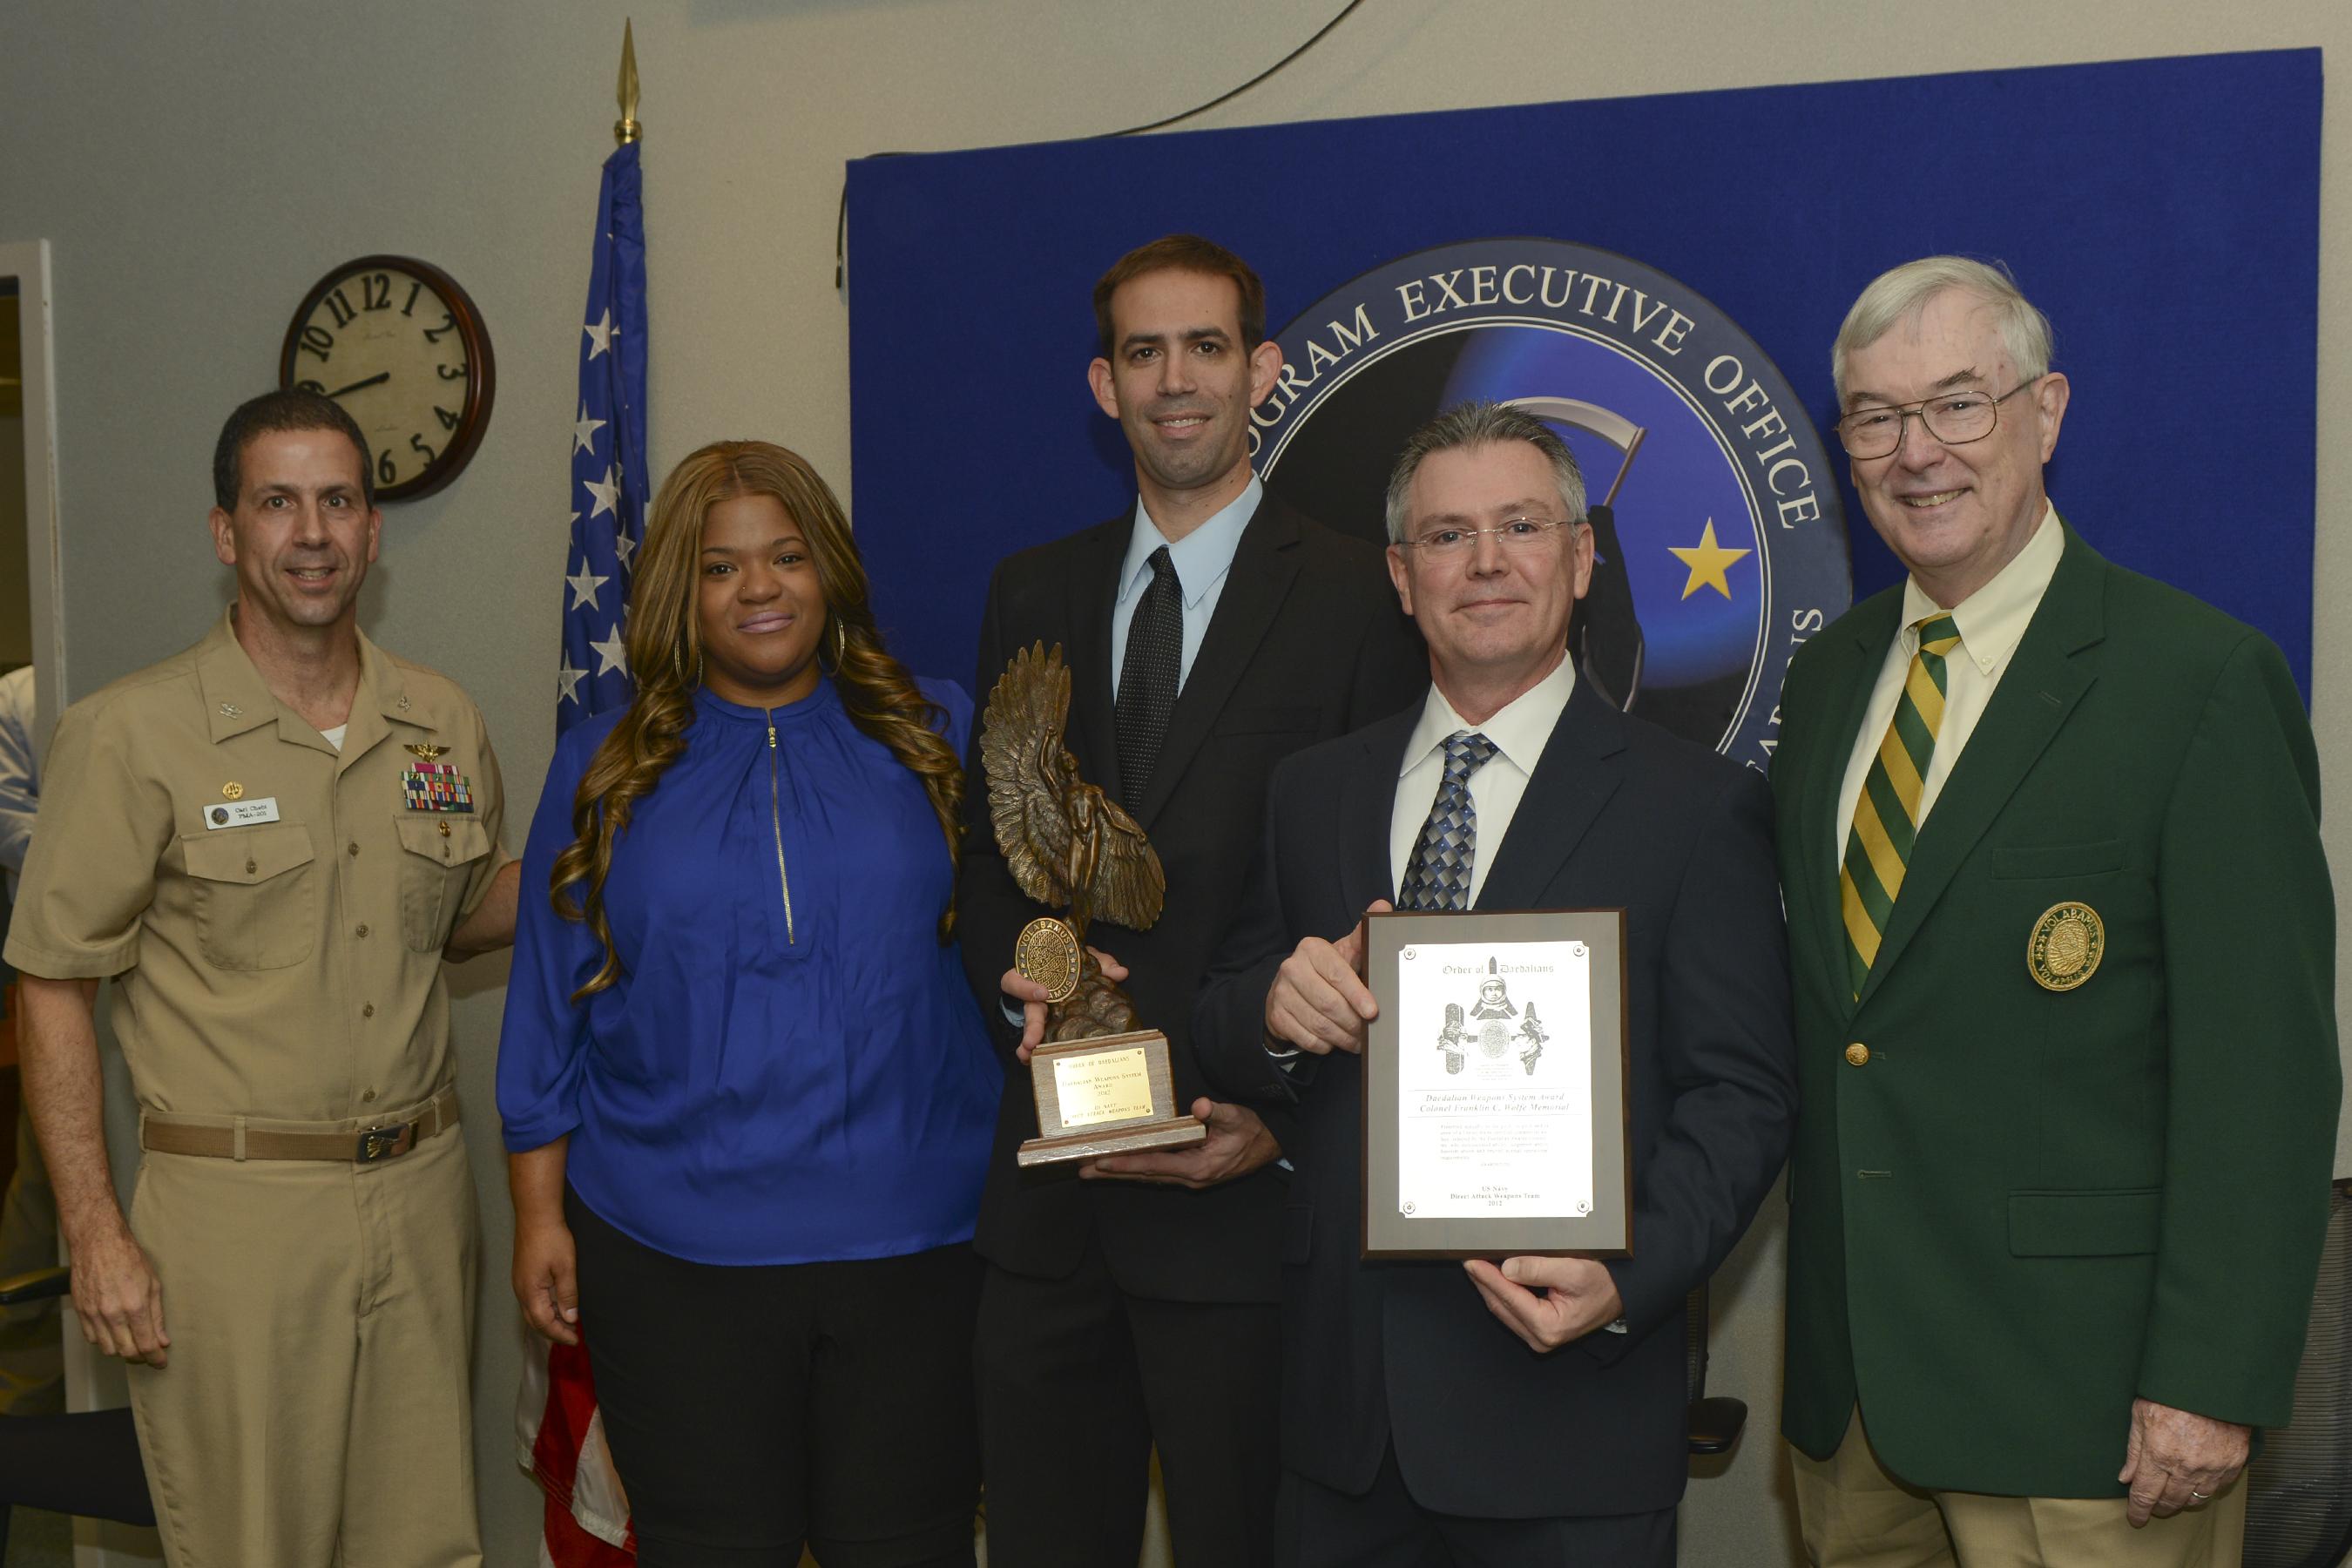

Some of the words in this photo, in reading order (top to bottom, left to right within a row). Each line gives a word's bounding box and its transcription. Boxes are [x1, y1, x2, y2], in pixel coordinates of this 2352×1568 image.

[361, 274, 391, 312] 12
[401, 282, 422, 317] 1
[325, 287, 357, 329] 11
[423, 314, 458, 343] 2
[301, 325, 334, 363] 10
[437, 362, 468, 381] 3
[1395, 264, 1695, 356] EXECUTIVE
[1704, 355, 1821, 529] OFFICE
[433, 405, 462, 430] 4
[410, 433, 436, 469] 5
[378, 449, 396, 484] 6
[1020, 921, 1071, 948] VOLABAMUS
[2041, 909, 2099, 938] VOLABAMUS
[1443, 965, 1472, 974] Order
[1476, 965, 1484, 974] of
[1500, 964, 1554, 974] Daedalians
[2038, 964, 2085, 984] VOLAMUS
[1048, 980, 1073, 1000] AMUS
[1098, 1057, 1130, 1065] DAEDALIANS
[1470, 1094, 1504, 1103] Weapons
[1508, 1094, 1536, 1103] System
[1505, 1104, 1527, 1112] Wolfe
